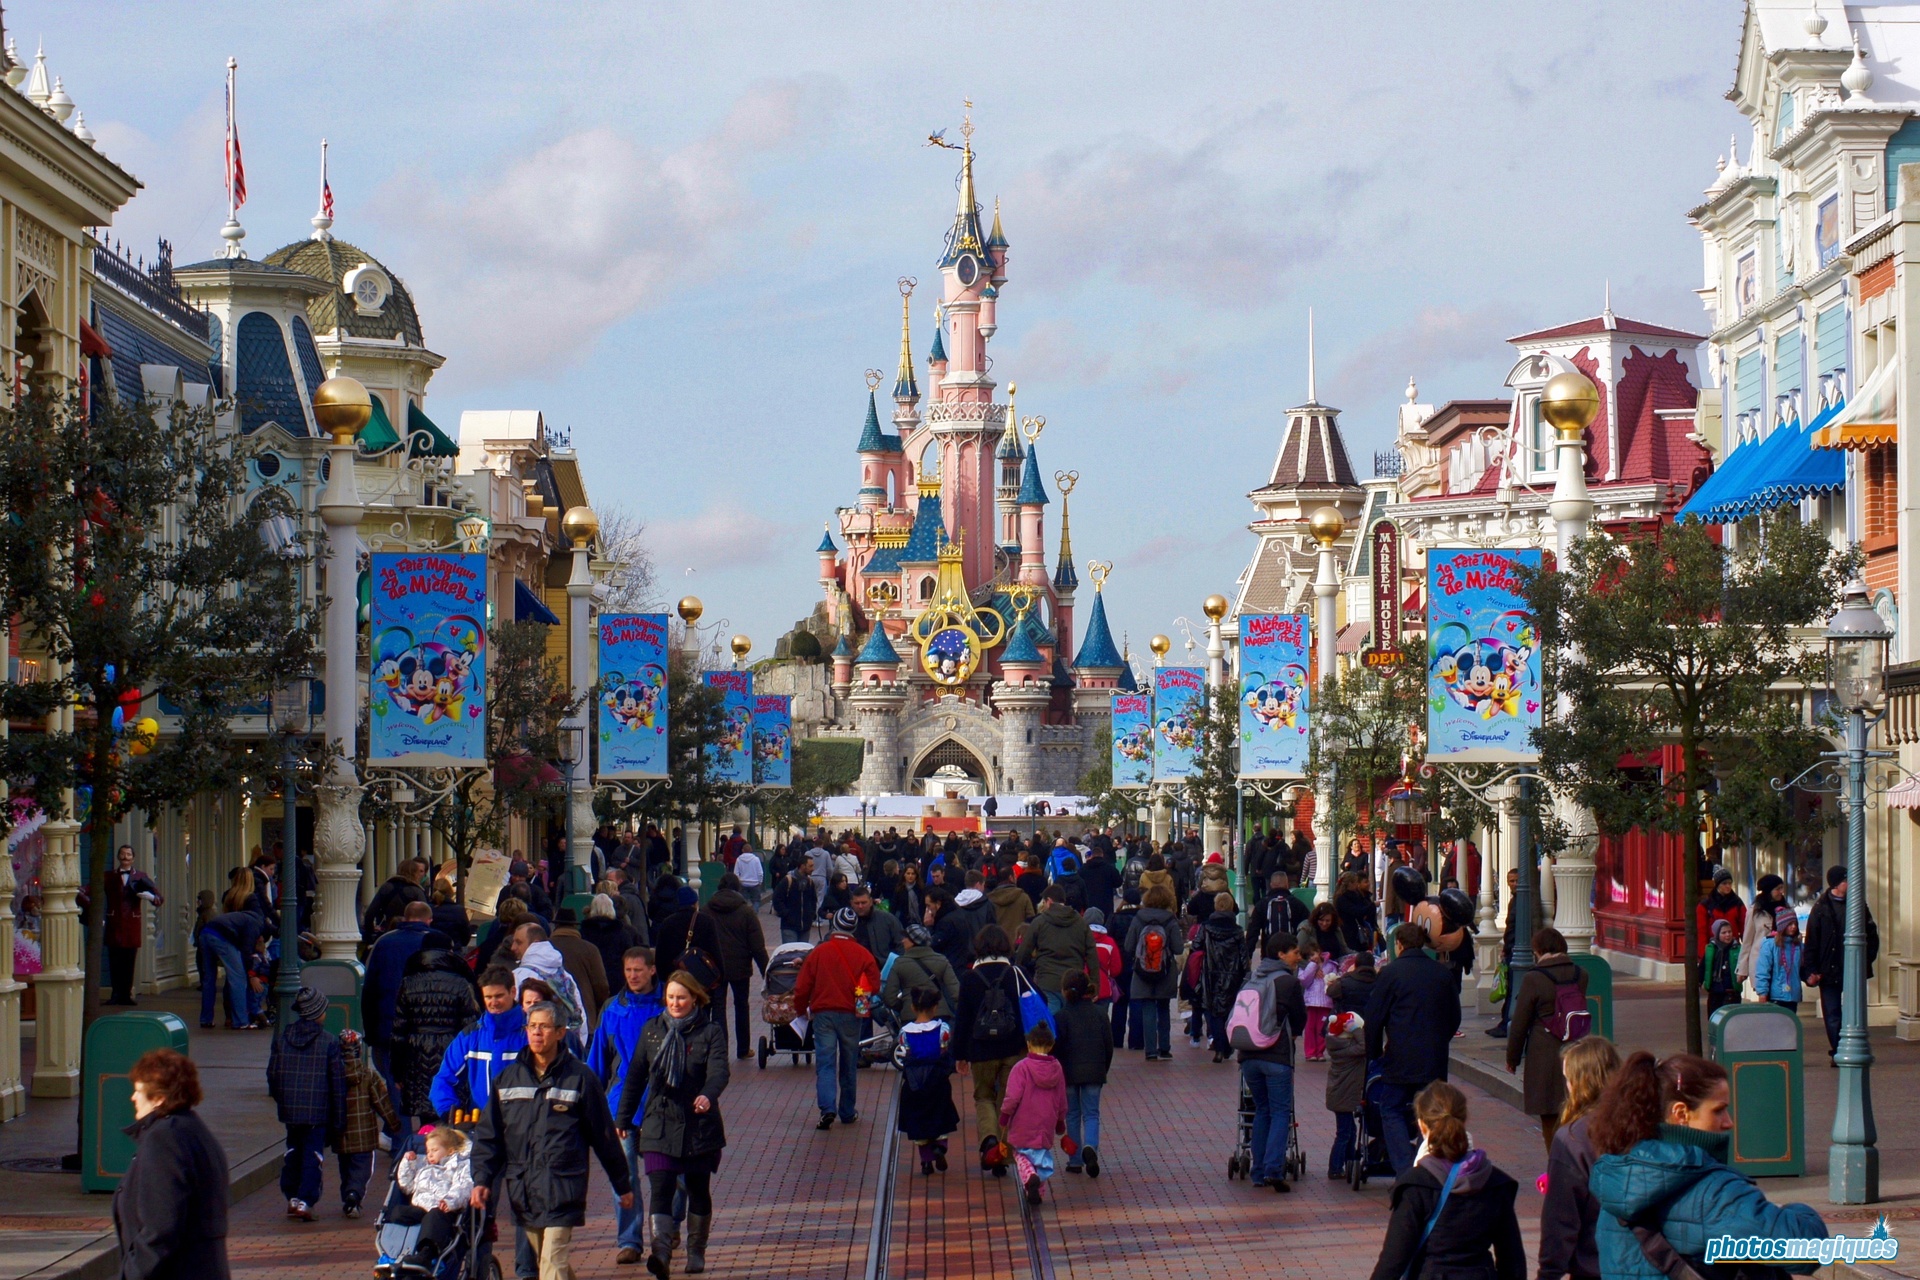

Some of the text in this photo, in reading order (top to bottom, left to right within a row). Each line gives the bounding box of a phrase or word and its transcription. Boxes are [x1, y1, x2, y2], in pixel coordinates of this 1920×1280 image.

[425, 556, 477, 580] Magique
[381, 574, 475, 604] de Mickey
[1379, 533, 1392, 650] MARKET HOUSE
[1437, 573, 1463, 596] de
[620, 628, 664, 649] Mickey
[1244, 630, 1305, 650] Magical Party
